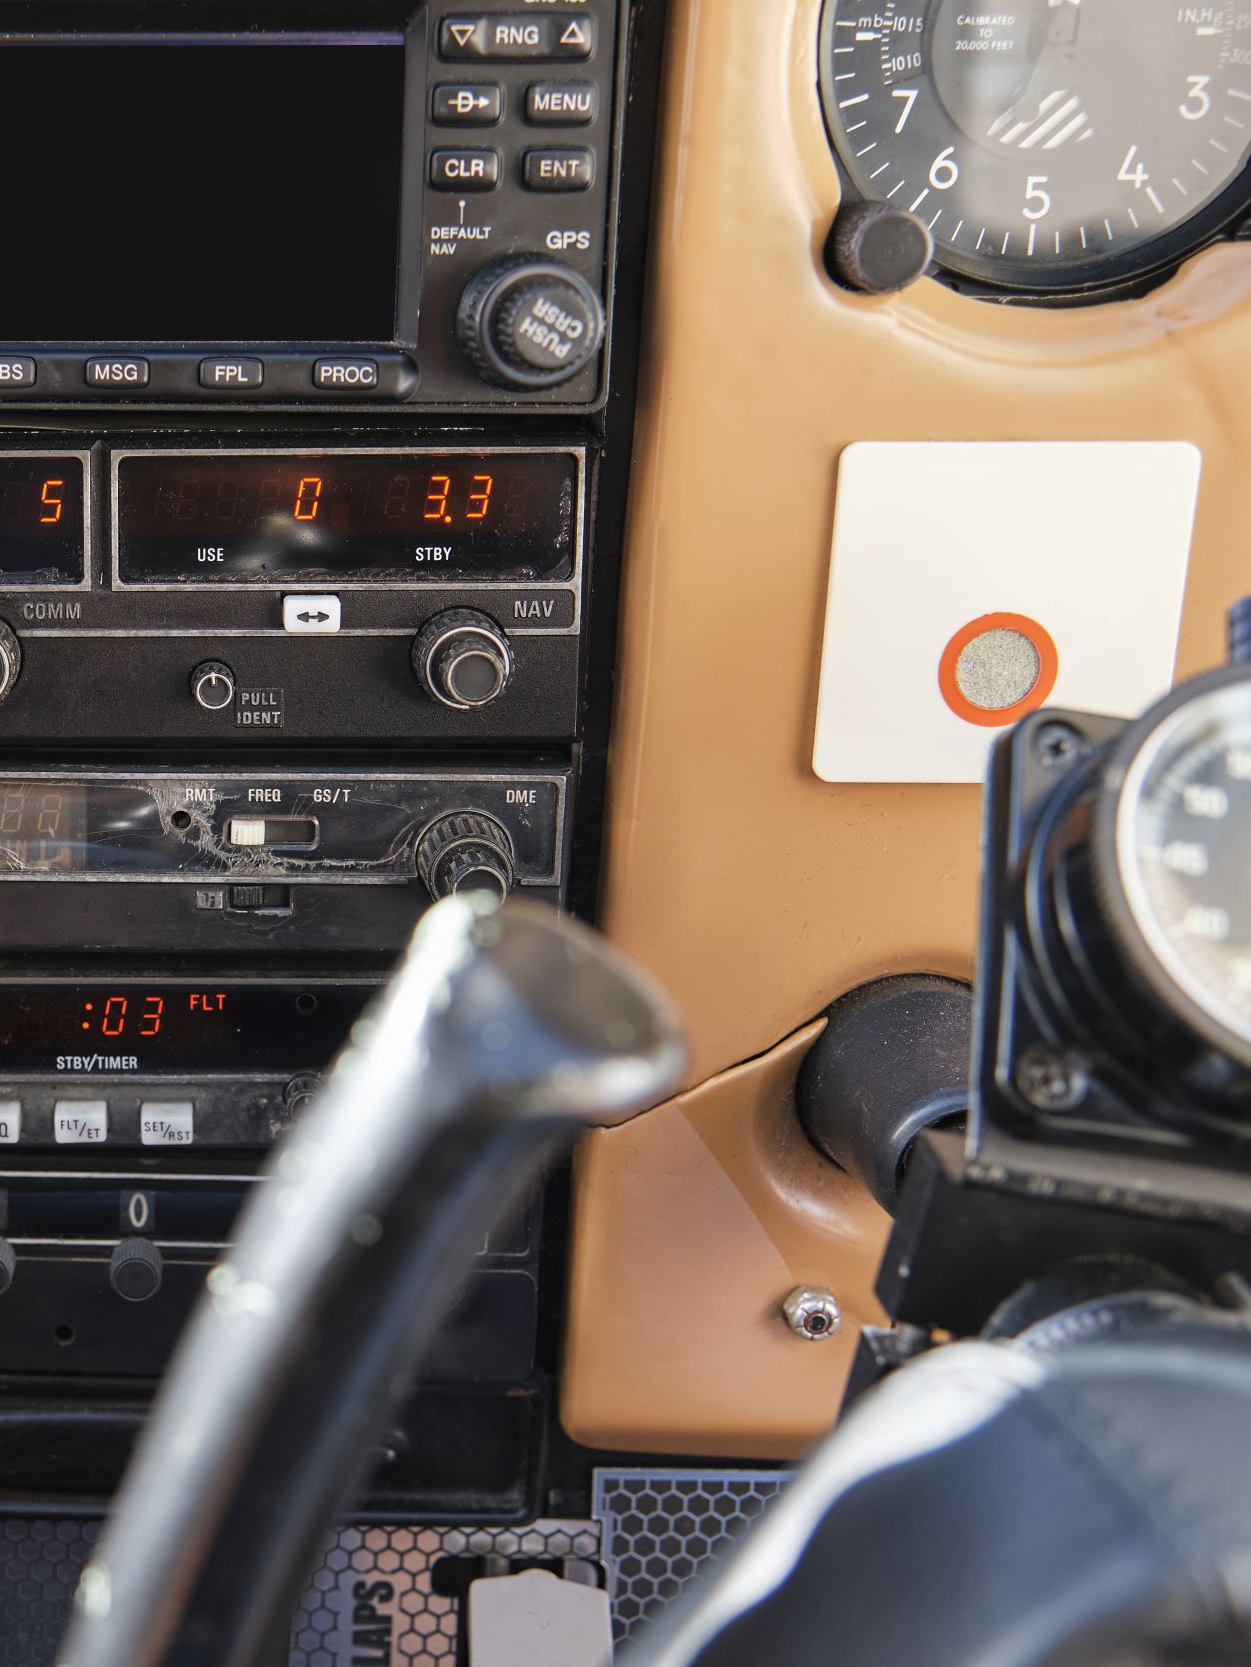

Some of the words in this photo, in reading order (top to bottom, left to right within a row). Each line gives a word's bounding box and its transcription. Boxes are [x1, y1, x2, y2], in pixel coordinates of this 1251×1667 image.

[858, 14, 883, 29] mb
[893, 16, 924, 33] 1015
[956, 15, 1015, 26] CALIBRATED
[495, 26, 539, 44] RNG
[979, 28, 993, 39] TO
[991, 41, 1014, 51] FEET
[891, 52, 923, 72] 1010
[534, 93, 590, 111] MENU
[1178, 75, 1210, 120] 3
[892, 89, 919, 134] 7
[445, 159, 484, 177] CLR
[540, 160, 579, 177] ENT
[928, 146, 959, 190] 6
[1116, 144, 1151, 189] 4
[1021, 176, 1051, 220] 5
[431, 227, 491, 239] DEFAULT
[546, 231, 590, 249] GPS
[430, 243, 457, 255] NAV
[532, 297, 583, 339] CRSR
[519, 316, 572, 359] PUSH
[95, 364, 138, 381] MSG
[215, 366, 248, 382] FPL
[321, 367, 373, 384] PROC
[294, 477, 322, 521] 0
[424, 475, 493, 523] 3.3
[197, 547, 224, 563] USE
[415, 546, 452, 561] STBY
[23, 602, 81, 620] COMM
[513, 600, 555, 619] NAV
[241, 692, 278, 706] PULL
[236, 711, 282, 726] IDENT
[185, 788, 216, 803] RMT
[248, 788, 281, 803] FREQ
[313, 788, 351, 804] GS/T
[506, 789, 537, 804] DME
[189, 994, 227, 1011] FLT
[56, 1054, 138, 1072] STBY/TIMER
[128, 1193, 149, 1228] 0
